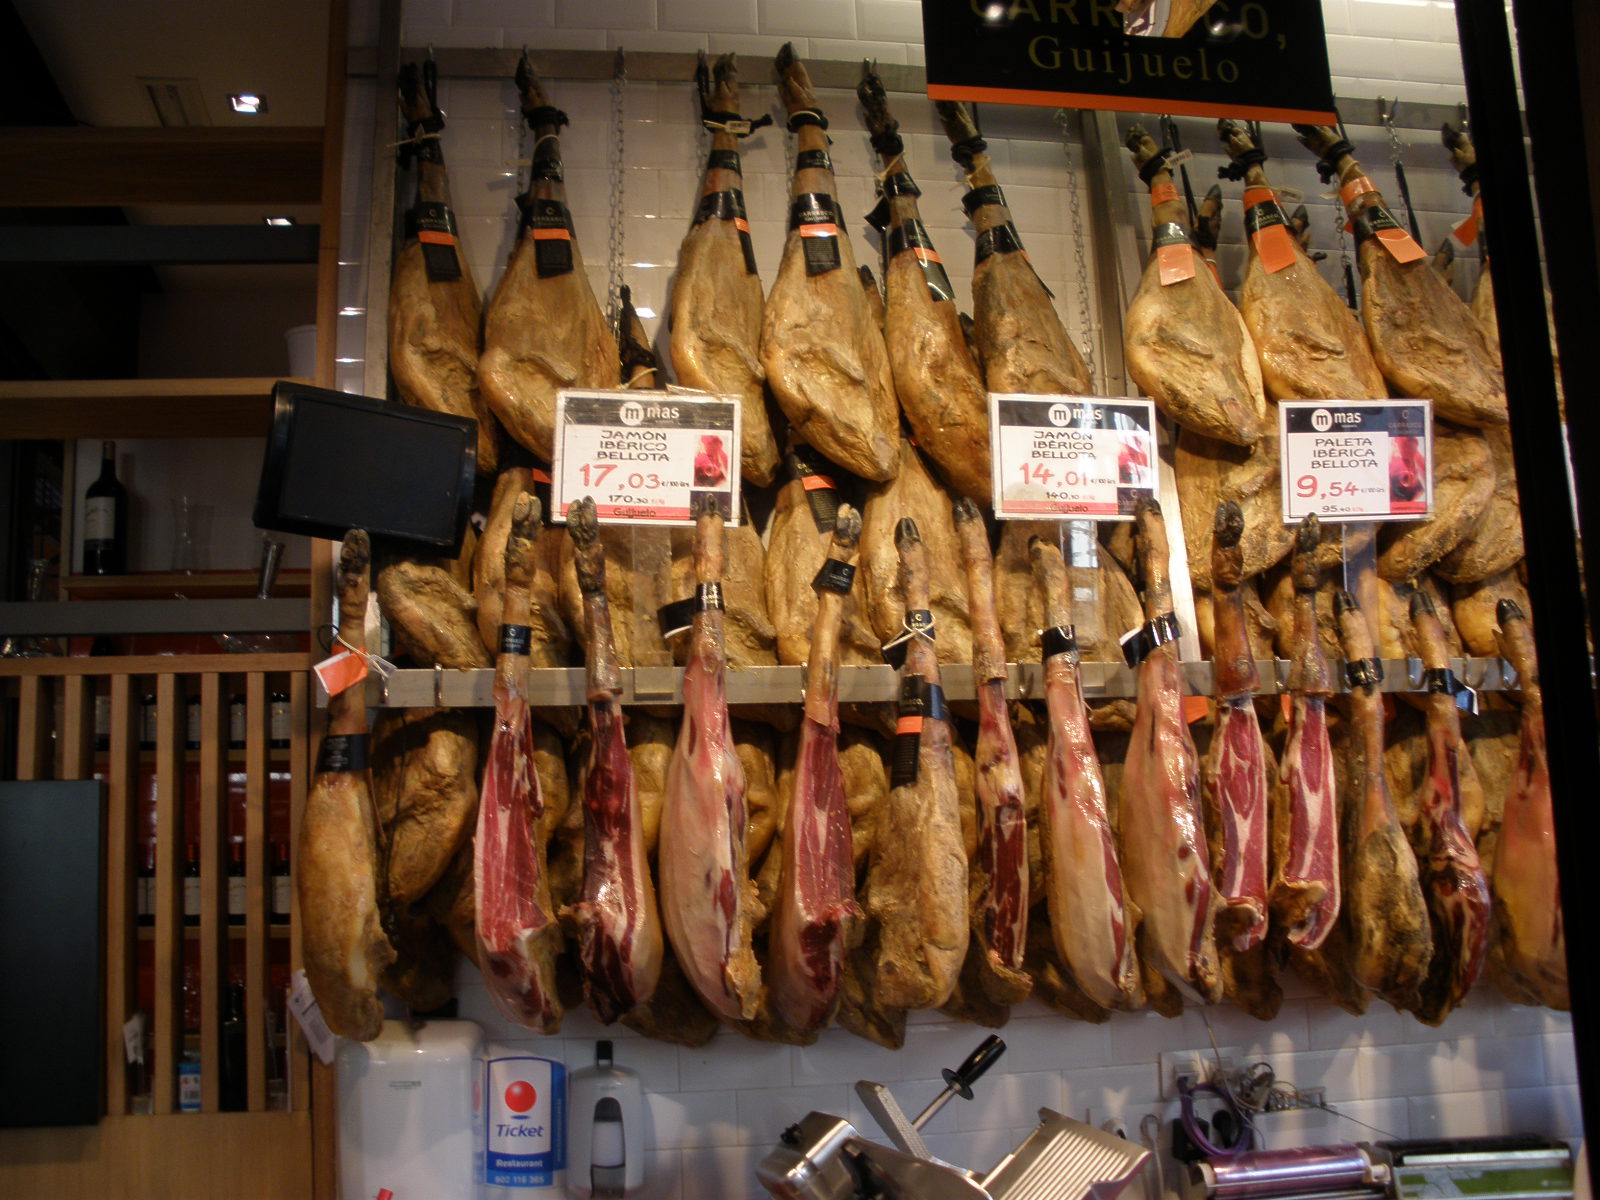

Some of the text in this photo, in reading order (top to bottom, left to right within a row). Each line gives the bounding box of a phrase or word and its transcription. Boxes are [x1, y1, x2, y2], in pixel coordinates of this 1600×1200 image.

[1028, 35, 1240, 84] Guijuelo
[646, 406, 680, 419] mas
[1334, 412, 1361, 424] mas
[1315, 437, 1373, 447] PALETA
[597, 451, 670, 462] BELLOTA
[1311, 459, 1379, 469] BELLOTA
[579, 463, 660, 491] 17,03
[1019, 463, 1088, 487] 14,01
[1297, 474, 1359, 500] 9,54
[496, 1124, 544, 1138] Ticket
[496, 1159, 543, 1169] Restaurant
